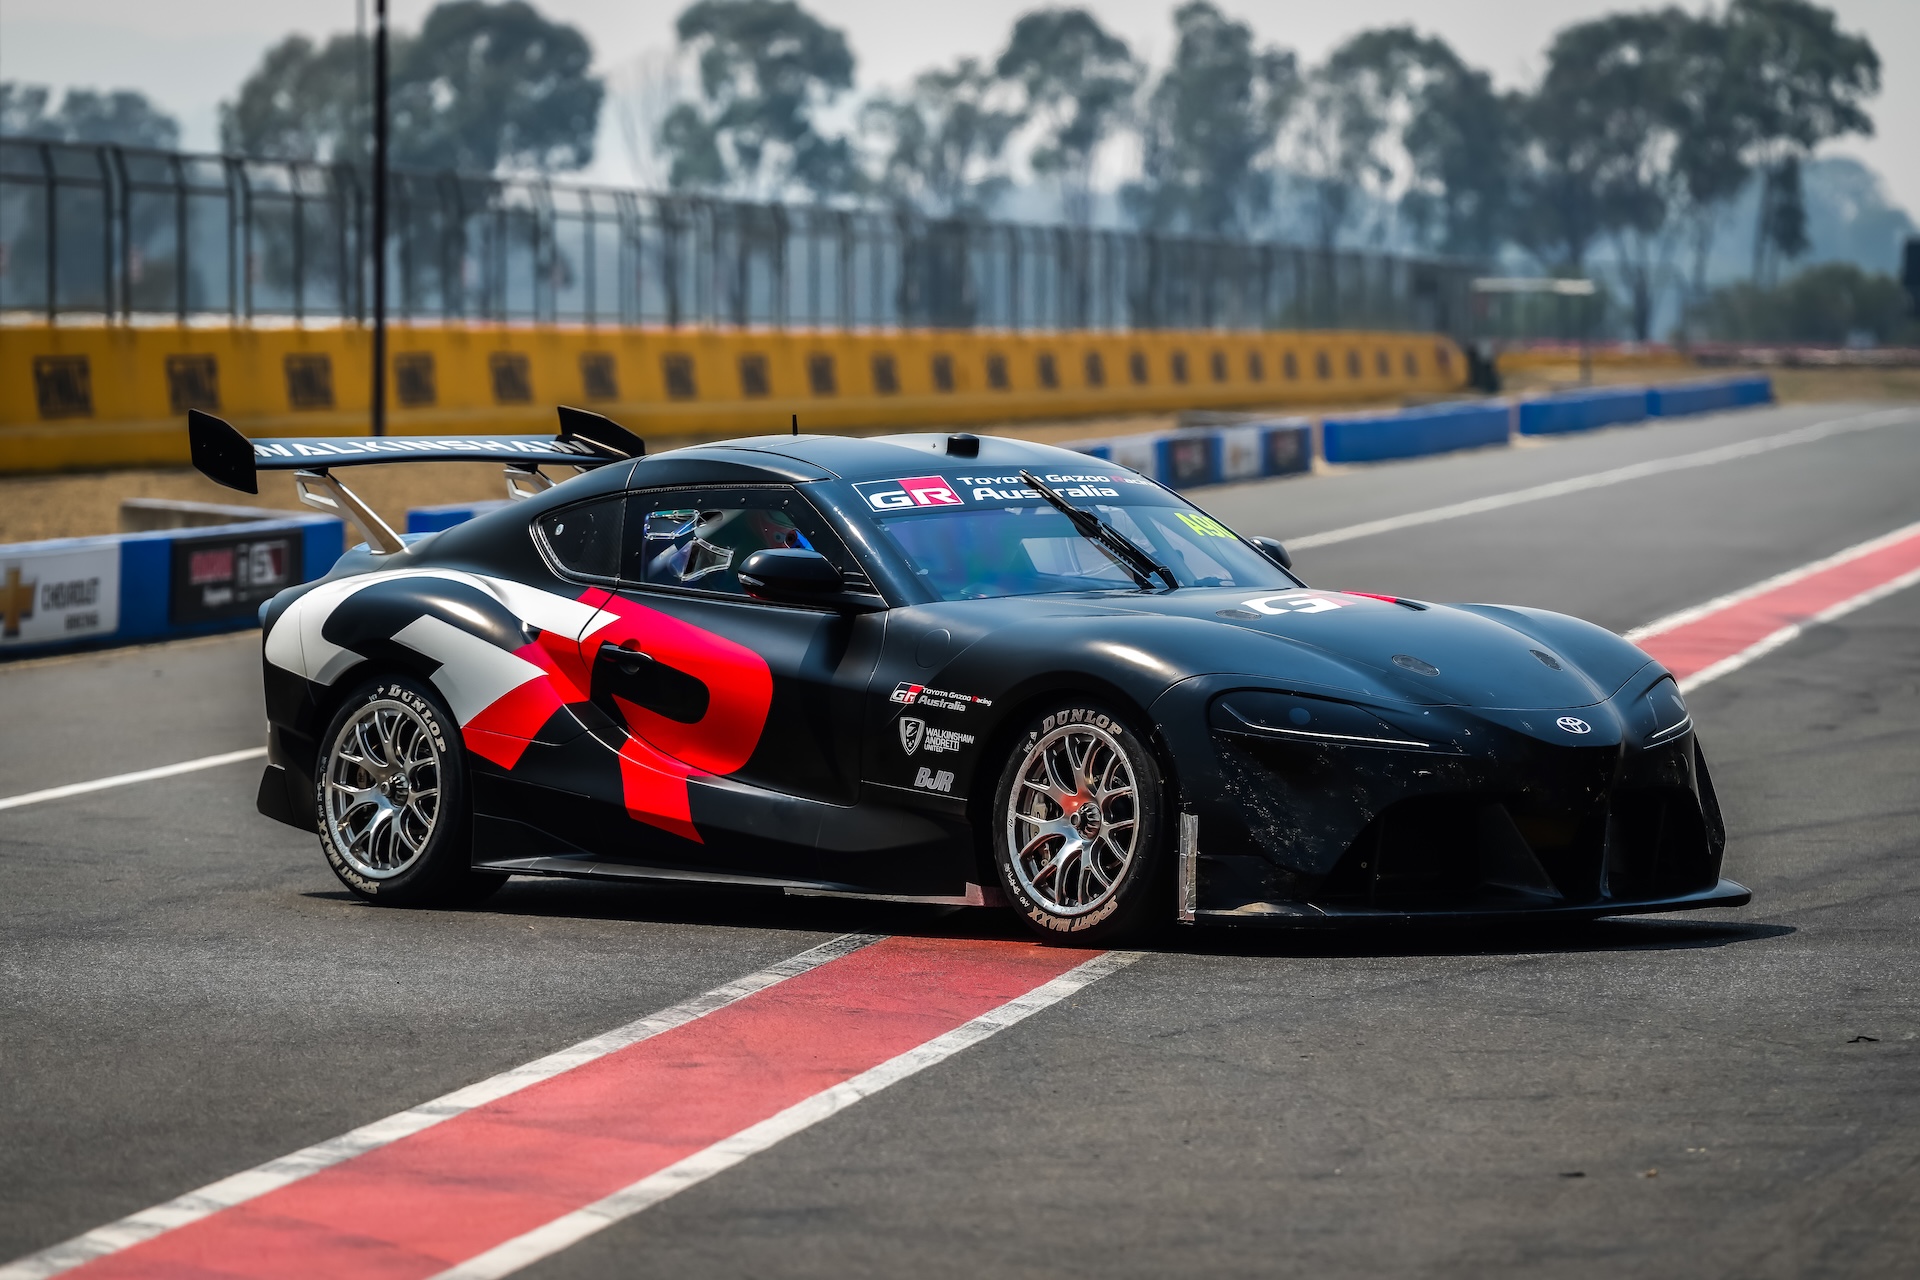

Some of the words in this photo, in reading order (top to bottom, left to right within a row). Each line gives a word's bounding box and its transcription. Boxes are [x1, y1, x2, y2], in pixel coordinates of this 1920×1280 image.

[253, 440, 595, 458] WALKINSHAW
[1045, 474, 1110, 484] GAZOO
[868, 487, 961, 509] GR
[972, 485, 1120, 500] Ausralia
[1174, 512, 1239, 541] A90
[892, 689, 918, 703] GR
[917, 695, 967, 712] Australia
[922, 687, 948, 698] TOYOTA
[948, 692, 972, 702] GAZOO
[971, 695, 993, 707] Racing
[388, 684, 447, 753] DUNLOP
[1042, 708, 1123, 736] DUNLOP
[924, 735, 960, 750] ANDRETTI
[925, 726, 975, 745] WALKINSHAW
[923, 743, 944, 753] UNITED
[914, 766, 955, 792] BJR
[317, 819, 343, 867] MAXX
[1027, 905, 1072, 933] MAXX
[1071, 895, 1118, 933] SPORT
